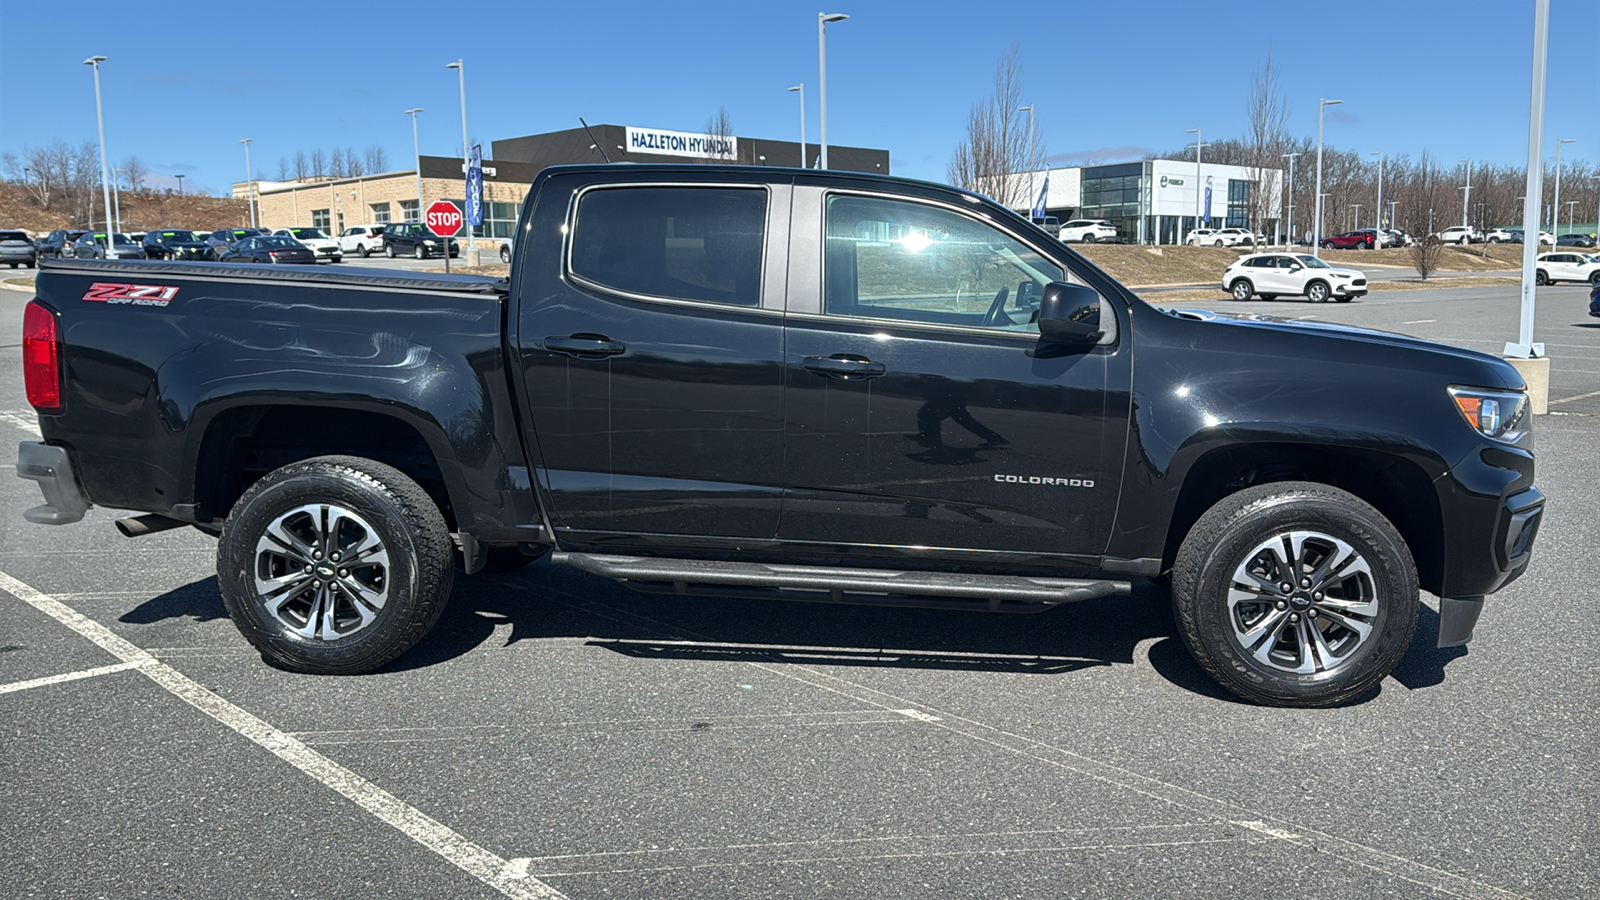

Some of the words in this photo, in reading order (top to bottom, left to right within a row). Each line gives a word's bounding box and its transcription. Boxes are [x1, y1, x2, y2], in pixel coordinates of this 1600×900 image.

[632, 132, 686, 151] HAZLETON
[689, 138, 732, 155] HYUNDAI
[428, 212, 460, 226] STOP
[82, 282, 180, 301] Z71
[107, 297, 131, 305] OFF
[131, 299, 170, 307] ROAD
[994, 474, 1094, 487] COLORADO
